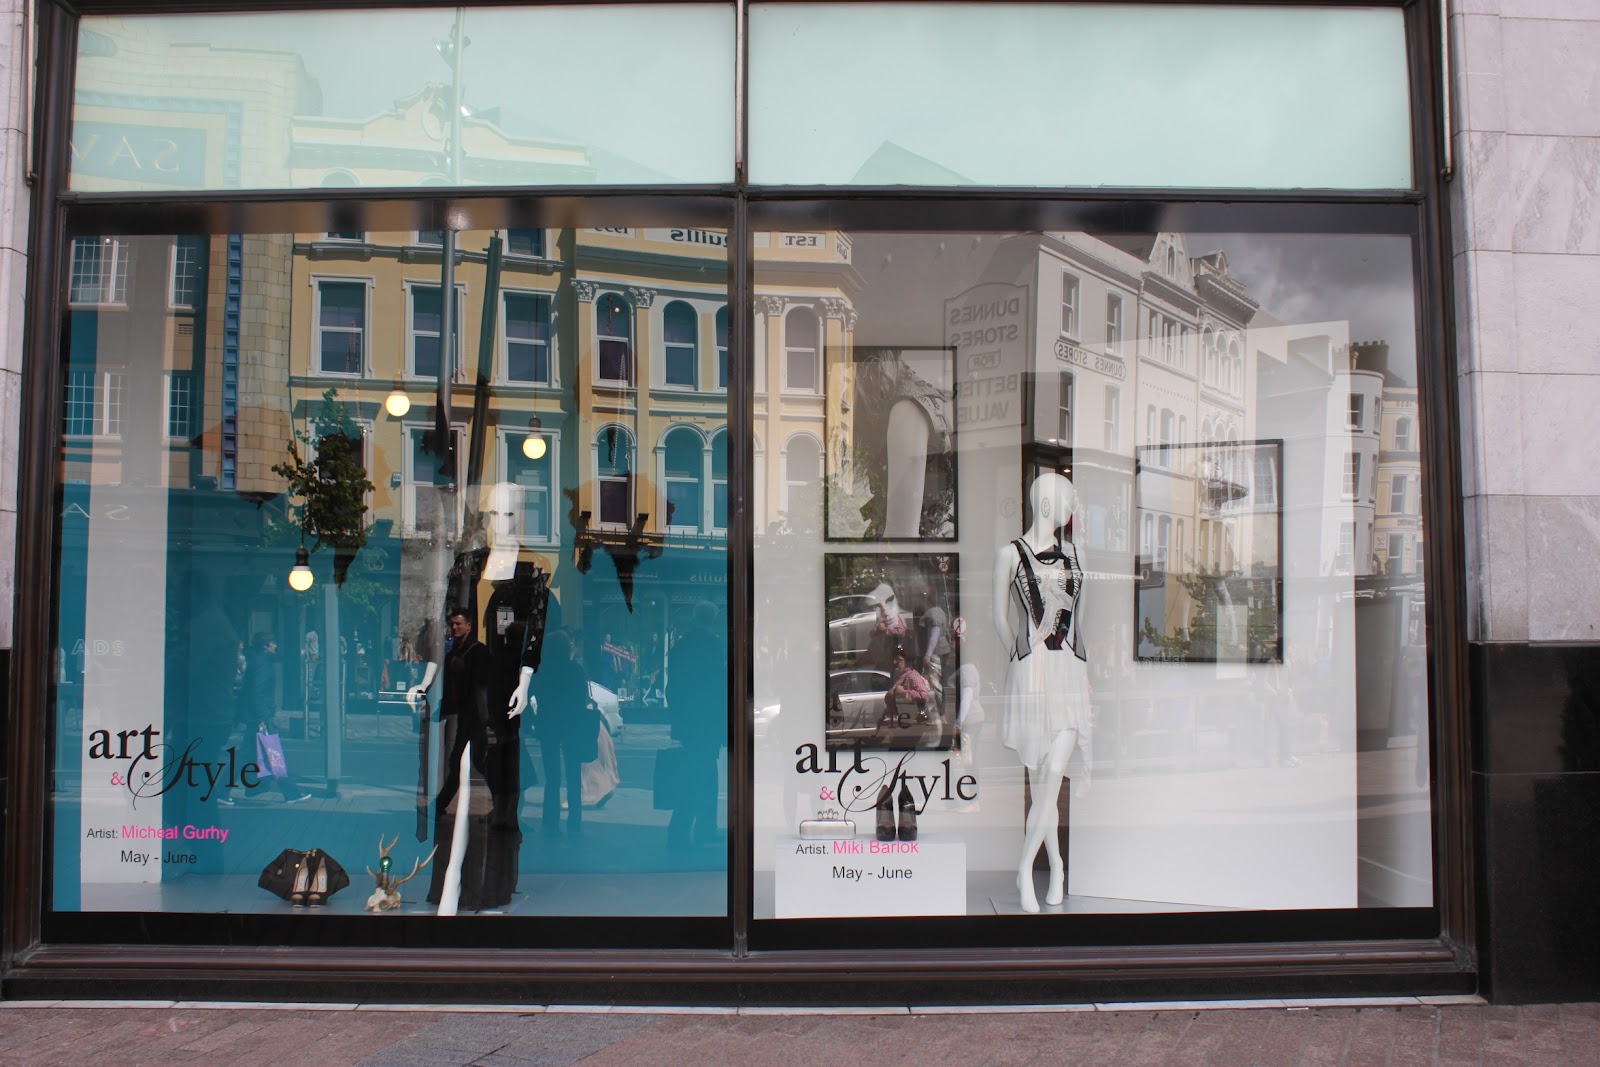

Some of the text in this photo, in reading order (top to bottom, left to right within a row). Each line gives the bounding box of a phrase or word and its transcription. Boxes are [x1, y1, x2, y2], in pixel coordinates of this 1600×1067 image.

[88, 723, 161, 760] art
[795, 737, 871, 773] art
[110, 771, 126, 786] &
[126, 737, 261, 811] Style
[819, 749, 978, 826] & Style
[86, 825, 230, 843] Artist: Micheal Gurhy
[832, 840, 865, 854] Miki
[869, 839, 920, 854] Barlok
[120, 850, 151, 866] May
[163, 851, 198, 864] June
[832, 866, 864, 882] May
[877, 866, 914, 879] June
